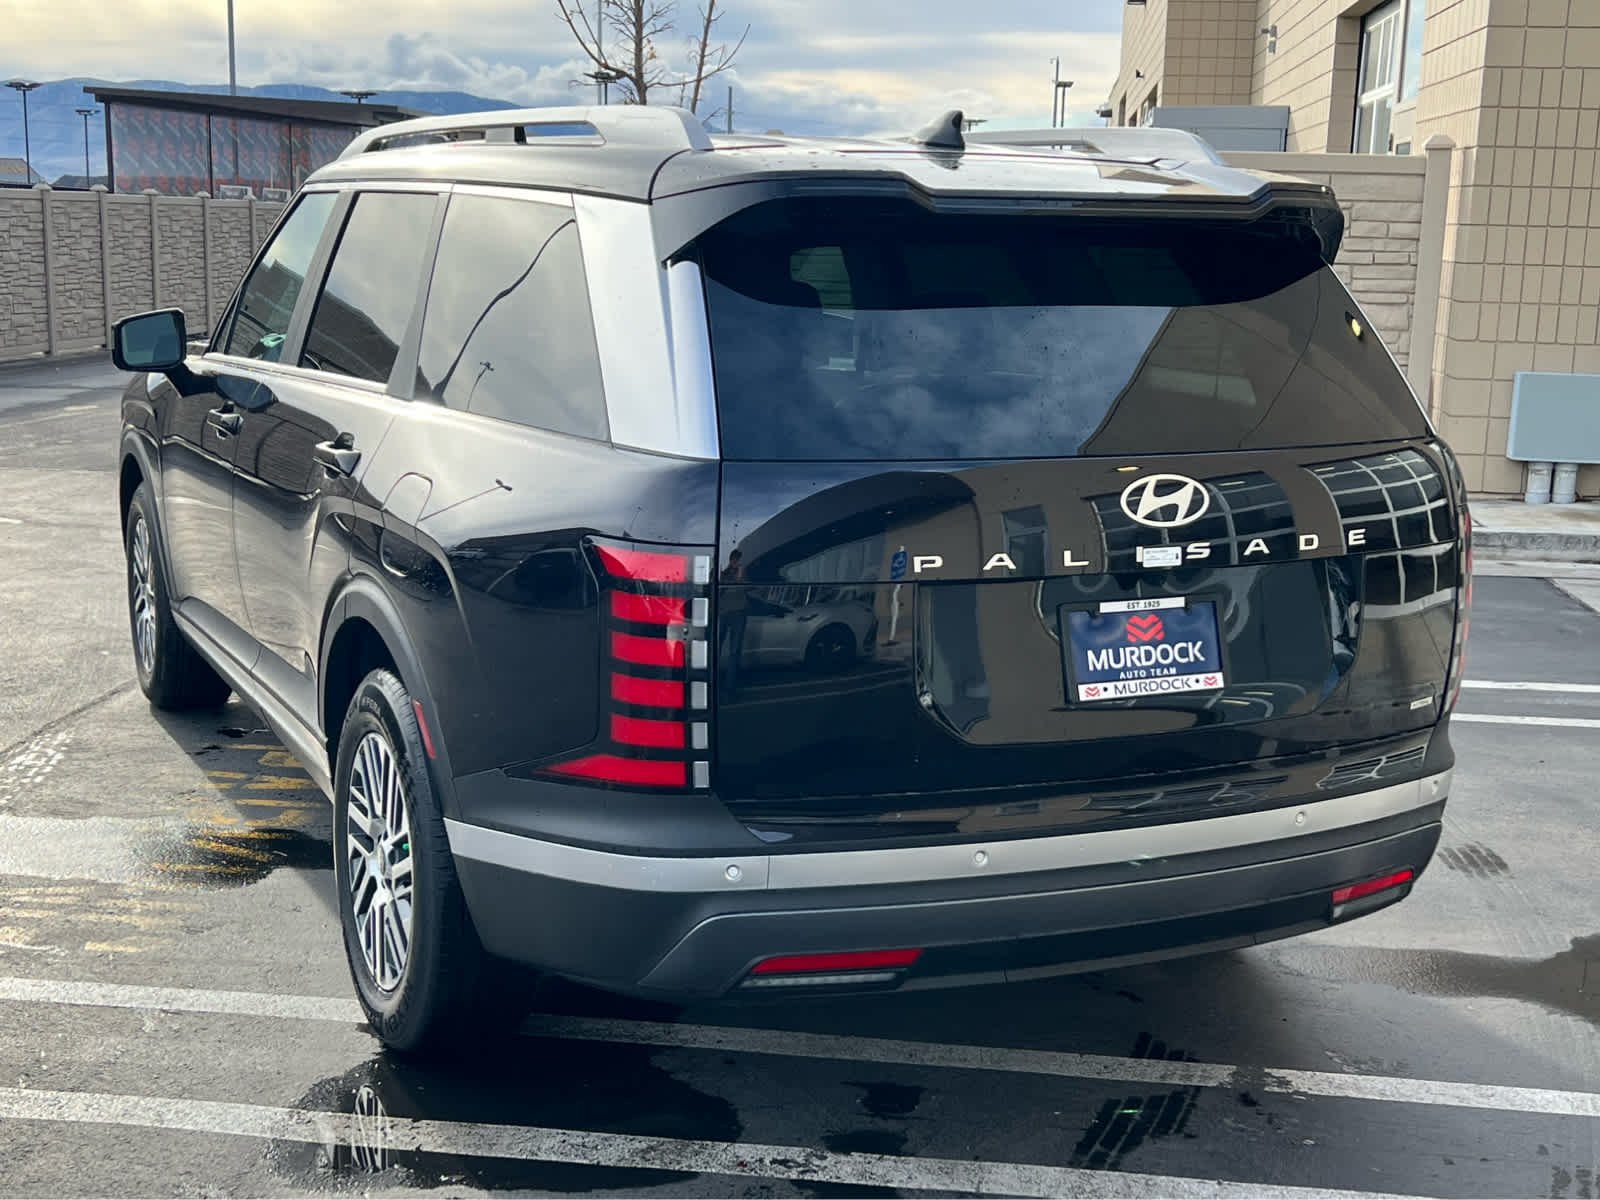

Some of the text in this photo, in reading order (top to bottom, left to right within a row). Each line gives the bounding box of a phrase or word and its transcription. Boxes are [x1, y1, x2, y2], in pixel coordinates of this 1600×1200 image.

[1087, 641, 1206, 672] MURDOCK
[1119, 666, 1178, 680] AUTO TEAM
[1113, 676, 1193, 696] MURDOCK
